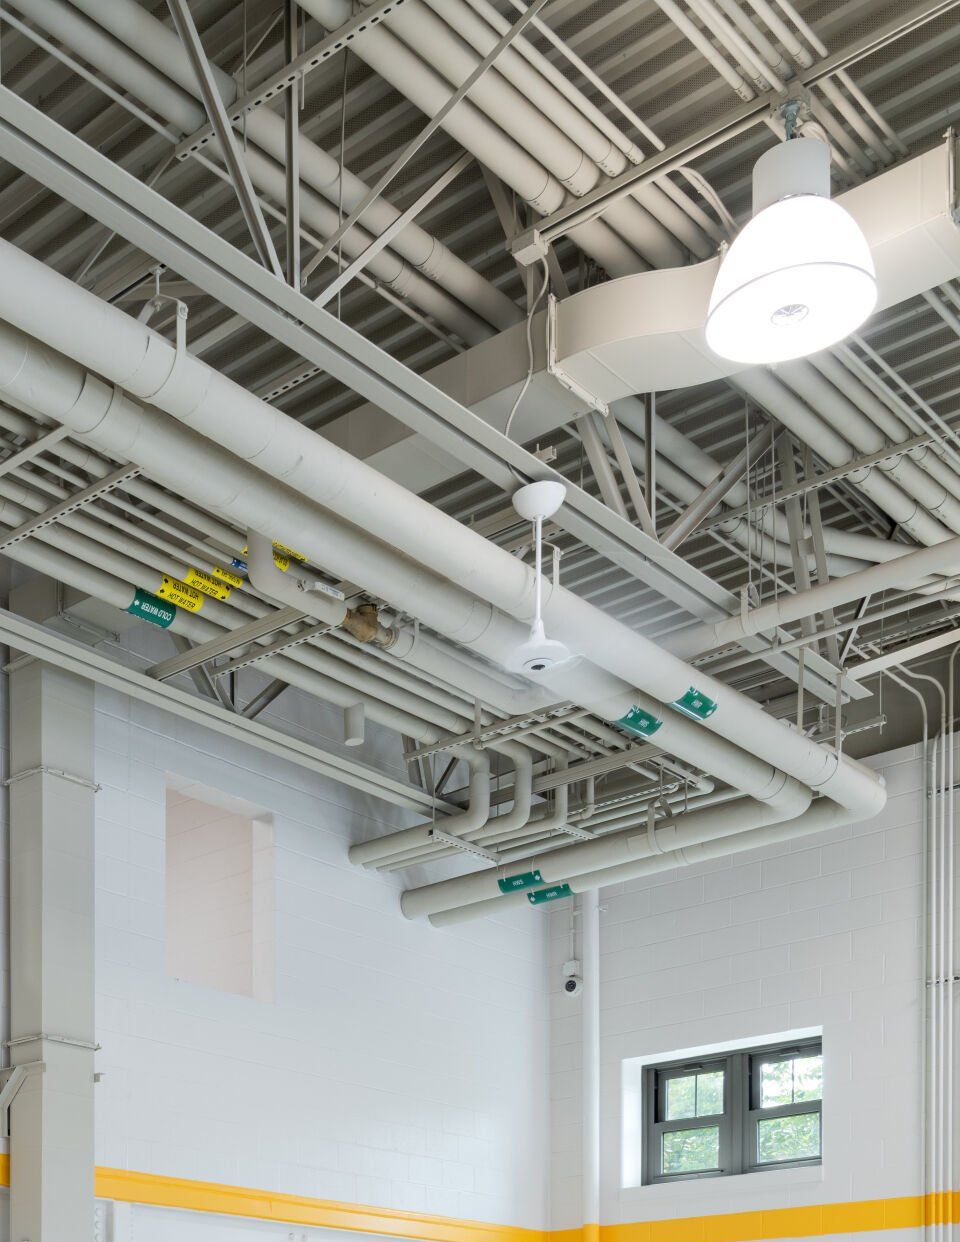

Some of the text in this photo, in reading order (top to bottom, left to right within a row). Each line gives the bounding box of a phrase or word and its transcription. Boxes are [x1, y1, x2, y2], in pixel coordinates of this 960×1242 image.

[191, 578, 219, 596] HOT WATER
[167, 591, 196, 609] HOT WATER
[141, 602, 158, 616] WATER
[158, 609, 172, 621] COLD
